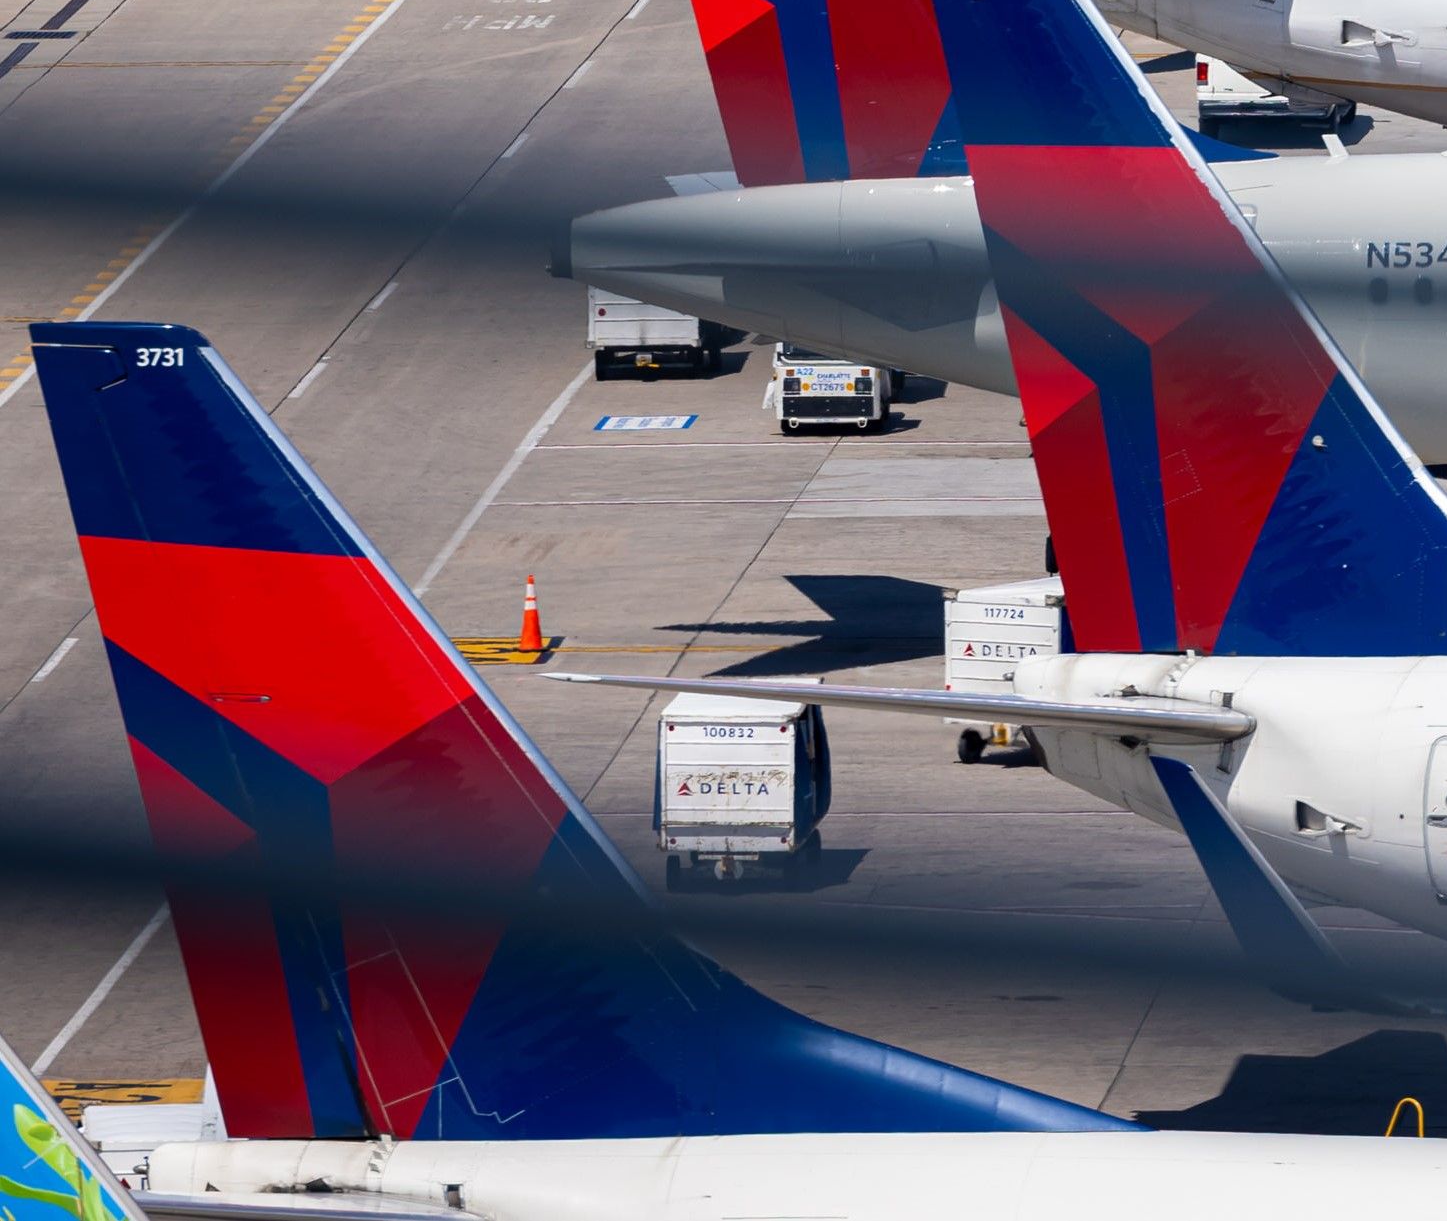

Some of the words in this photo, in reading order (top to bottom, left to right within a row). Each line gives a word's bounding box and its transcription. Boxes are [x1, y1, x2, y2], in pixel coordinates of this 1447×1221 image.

[136, 348, 184, 367] 3731
[985, 608, 1024, 619] 117724
[982, 644, 1037, 658] DELTA
[702, 726, 755, 739] 100832
[700, 782, 770, 796] DELTA
